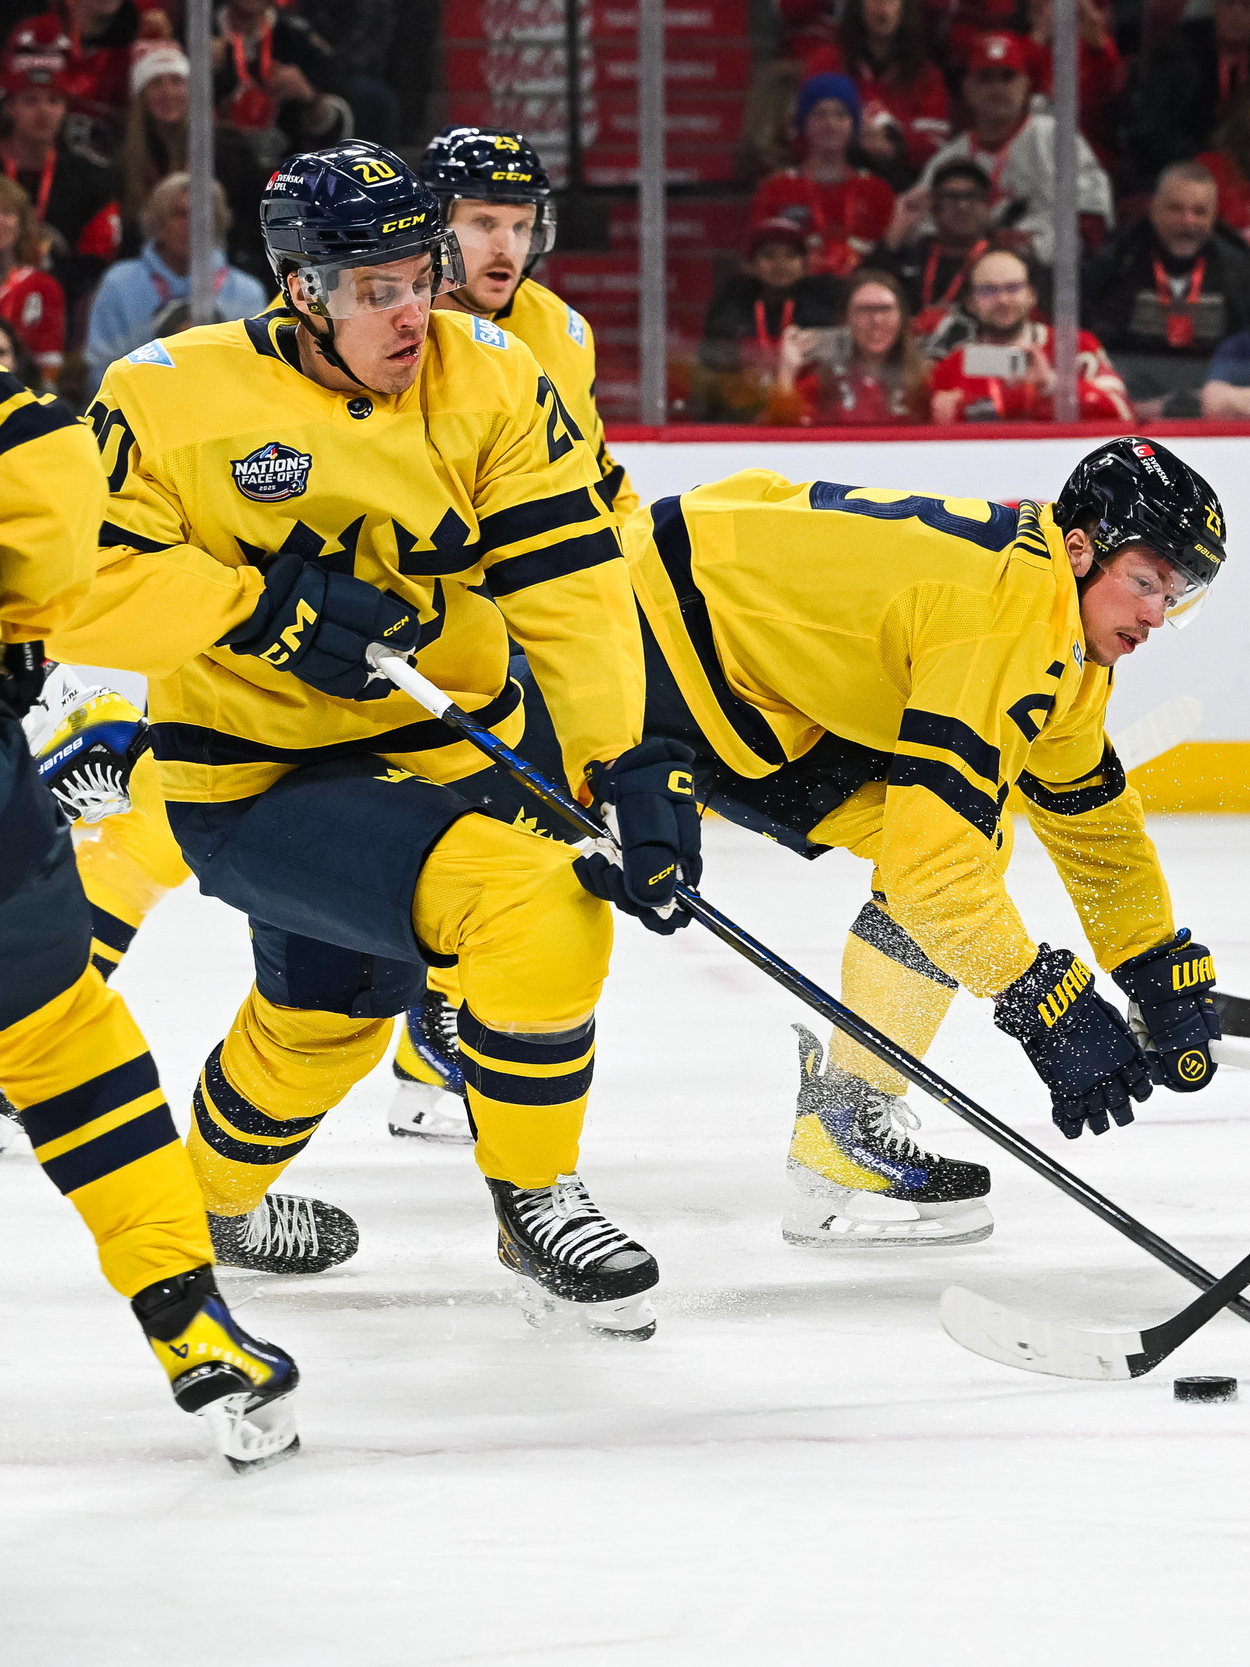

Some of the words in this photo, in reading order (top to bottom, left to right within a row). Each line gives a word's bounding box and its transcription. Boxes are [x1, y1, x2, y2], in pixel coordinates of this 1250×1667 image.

[276, 173, 304, 185] SVENSKA
[353, 160, 396, 184] 20
[491, 171, 532, 183] CCM
[273, 182, 287, 191] SPEL
[382, 213, 426, 234] CCM
[234, 456, 310, 476] NATIONS
[1140, 458, 1154, 475] SPEL
[1147, 455, 1171, 487] SVENSKA
[241, 469, 302, 485] FACE-OFF
[258, 484, 277, 492] 2025
[1193, 543, 1222, 565] BAUER
[258, 597, 319, 666] CM
[383, 615, 410, 638] CCM
[648, 863, 675, 886] CCM
